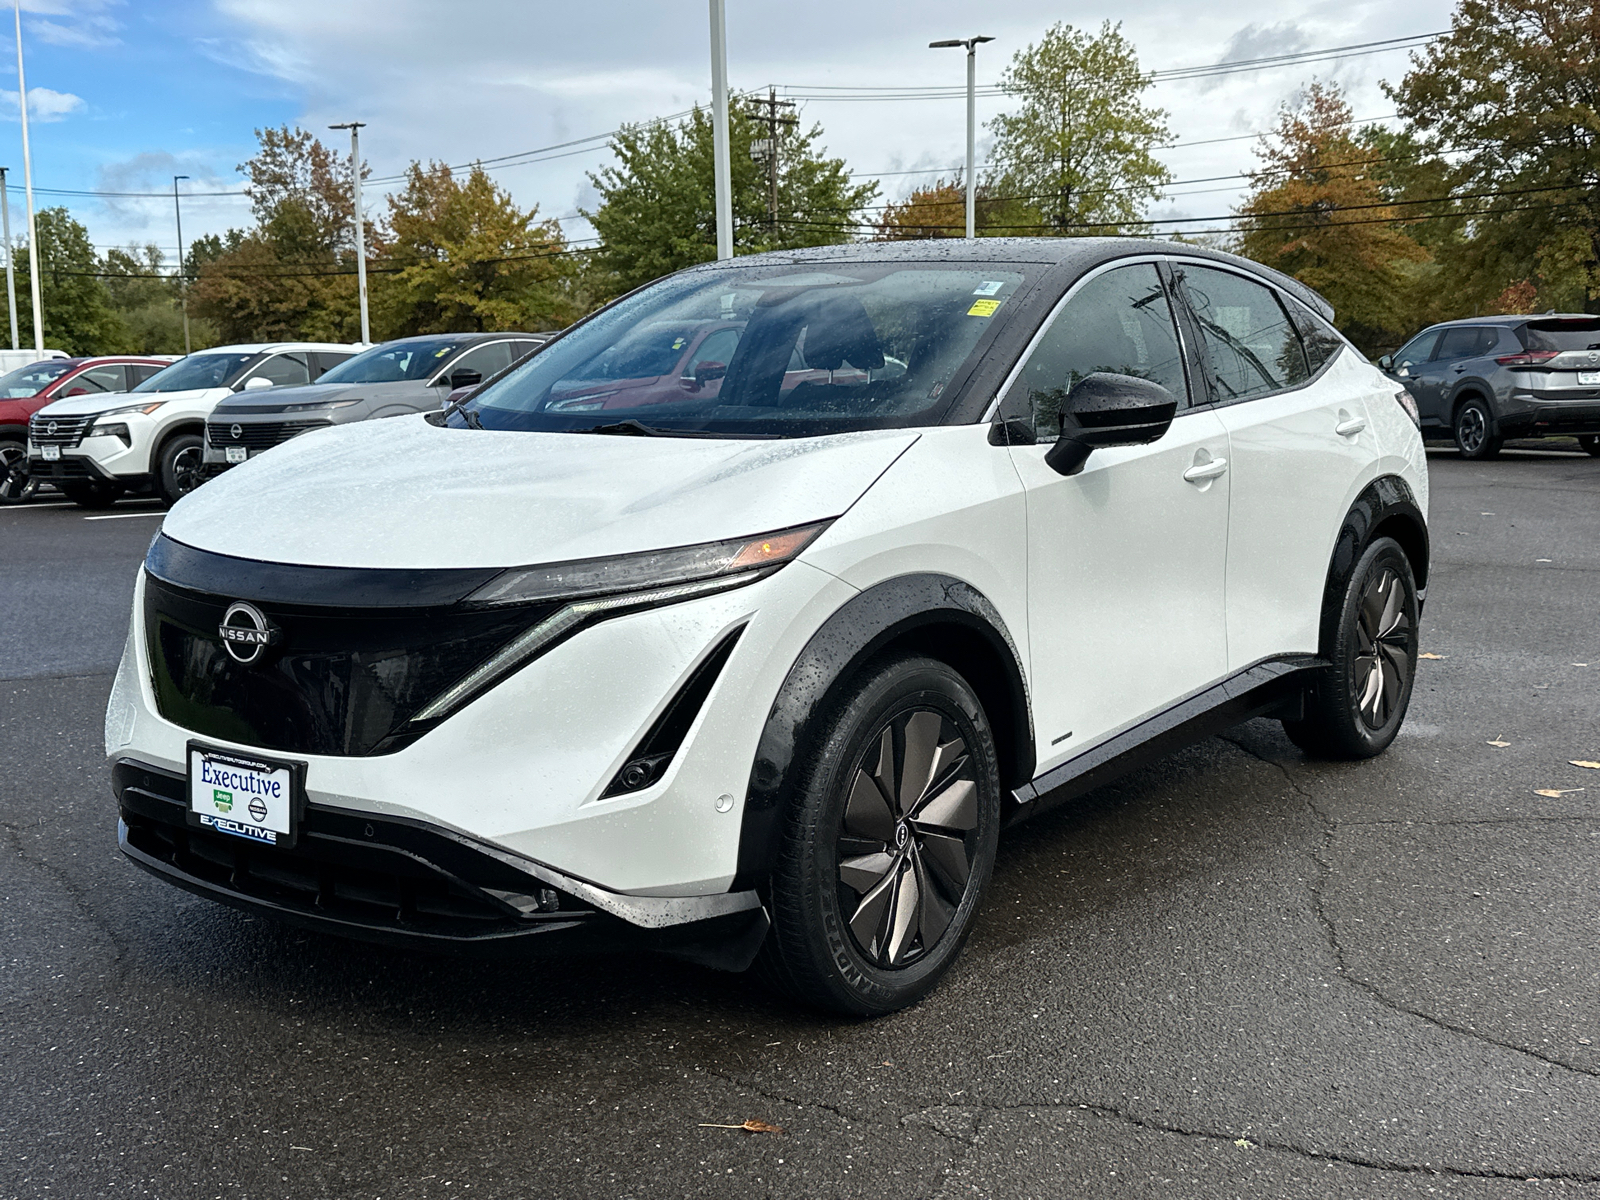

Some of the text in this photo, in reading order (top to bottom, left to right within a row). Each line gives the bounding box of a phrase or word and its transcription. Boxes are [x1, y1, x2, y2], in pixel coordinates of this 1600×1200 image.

[219, 627, 267, 643] NISSAN
[201, 760, 281, 798] Executive
[216, 791, 231, 802] Jeep
[200, 814, 277, 841] EXECUTIVE
